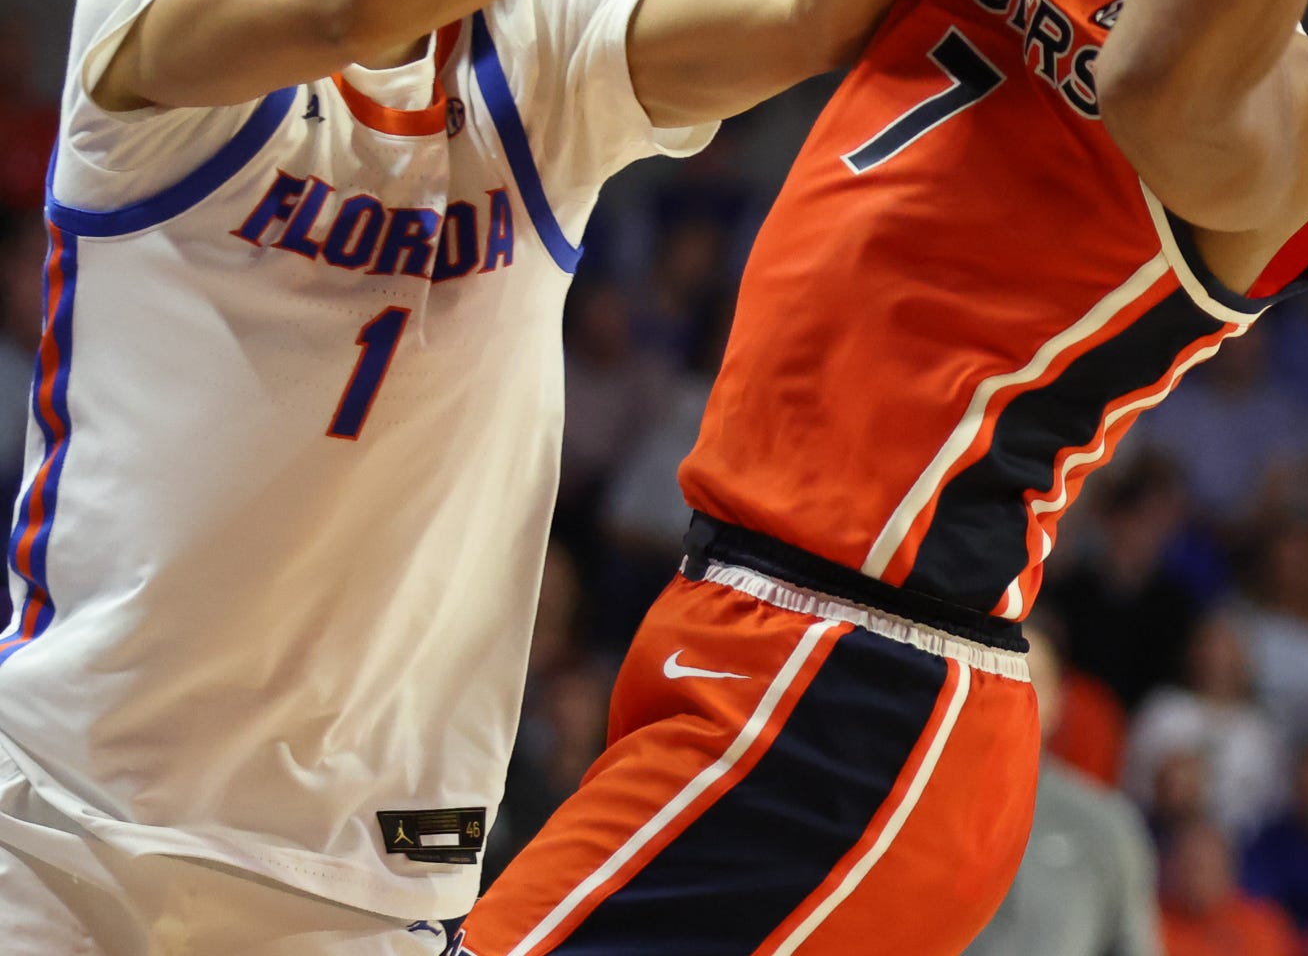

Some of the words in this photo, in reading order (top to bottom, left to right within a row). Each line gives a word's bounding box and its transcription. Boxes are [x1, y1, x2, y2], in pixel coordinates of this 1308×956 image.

[841, 25, 1007, 175] 7
[229, 167, 514, 284] FLORDA
[326, 305, 412, 440] 1
[466, 821, 481, 839] 46
